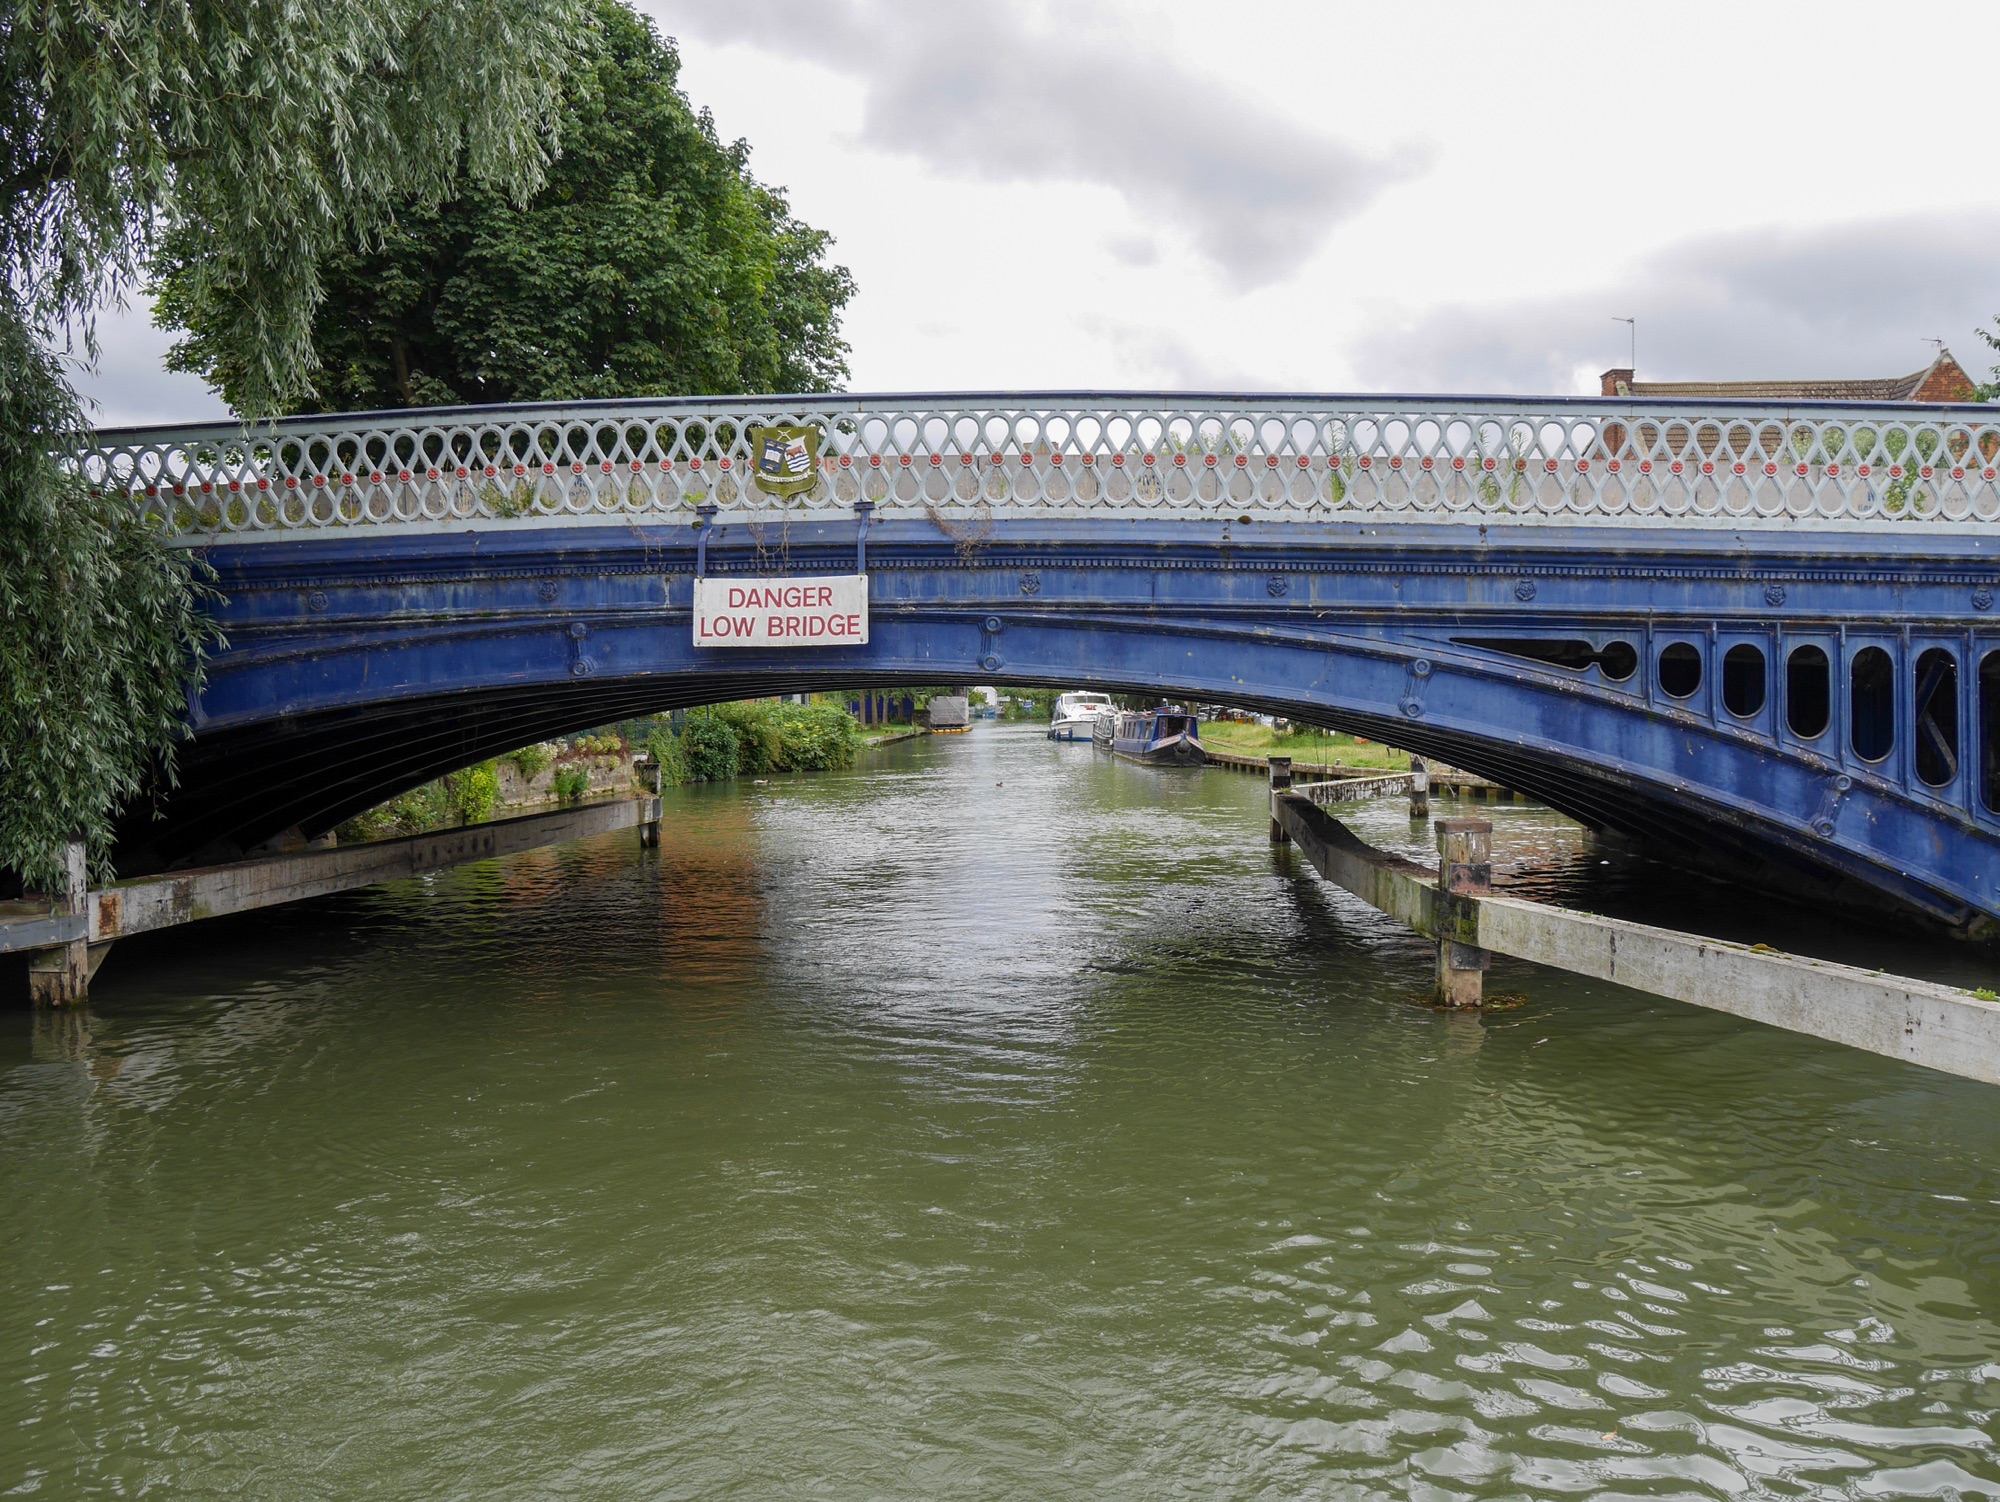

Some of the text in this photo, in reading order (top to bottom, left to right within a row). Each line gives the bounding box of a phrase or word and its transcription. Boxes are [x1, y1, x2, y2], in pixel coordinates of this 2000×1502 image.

[729, 587, 833, 608] DANGER
[701, 614, 861, 637] LOW BRIDGE
